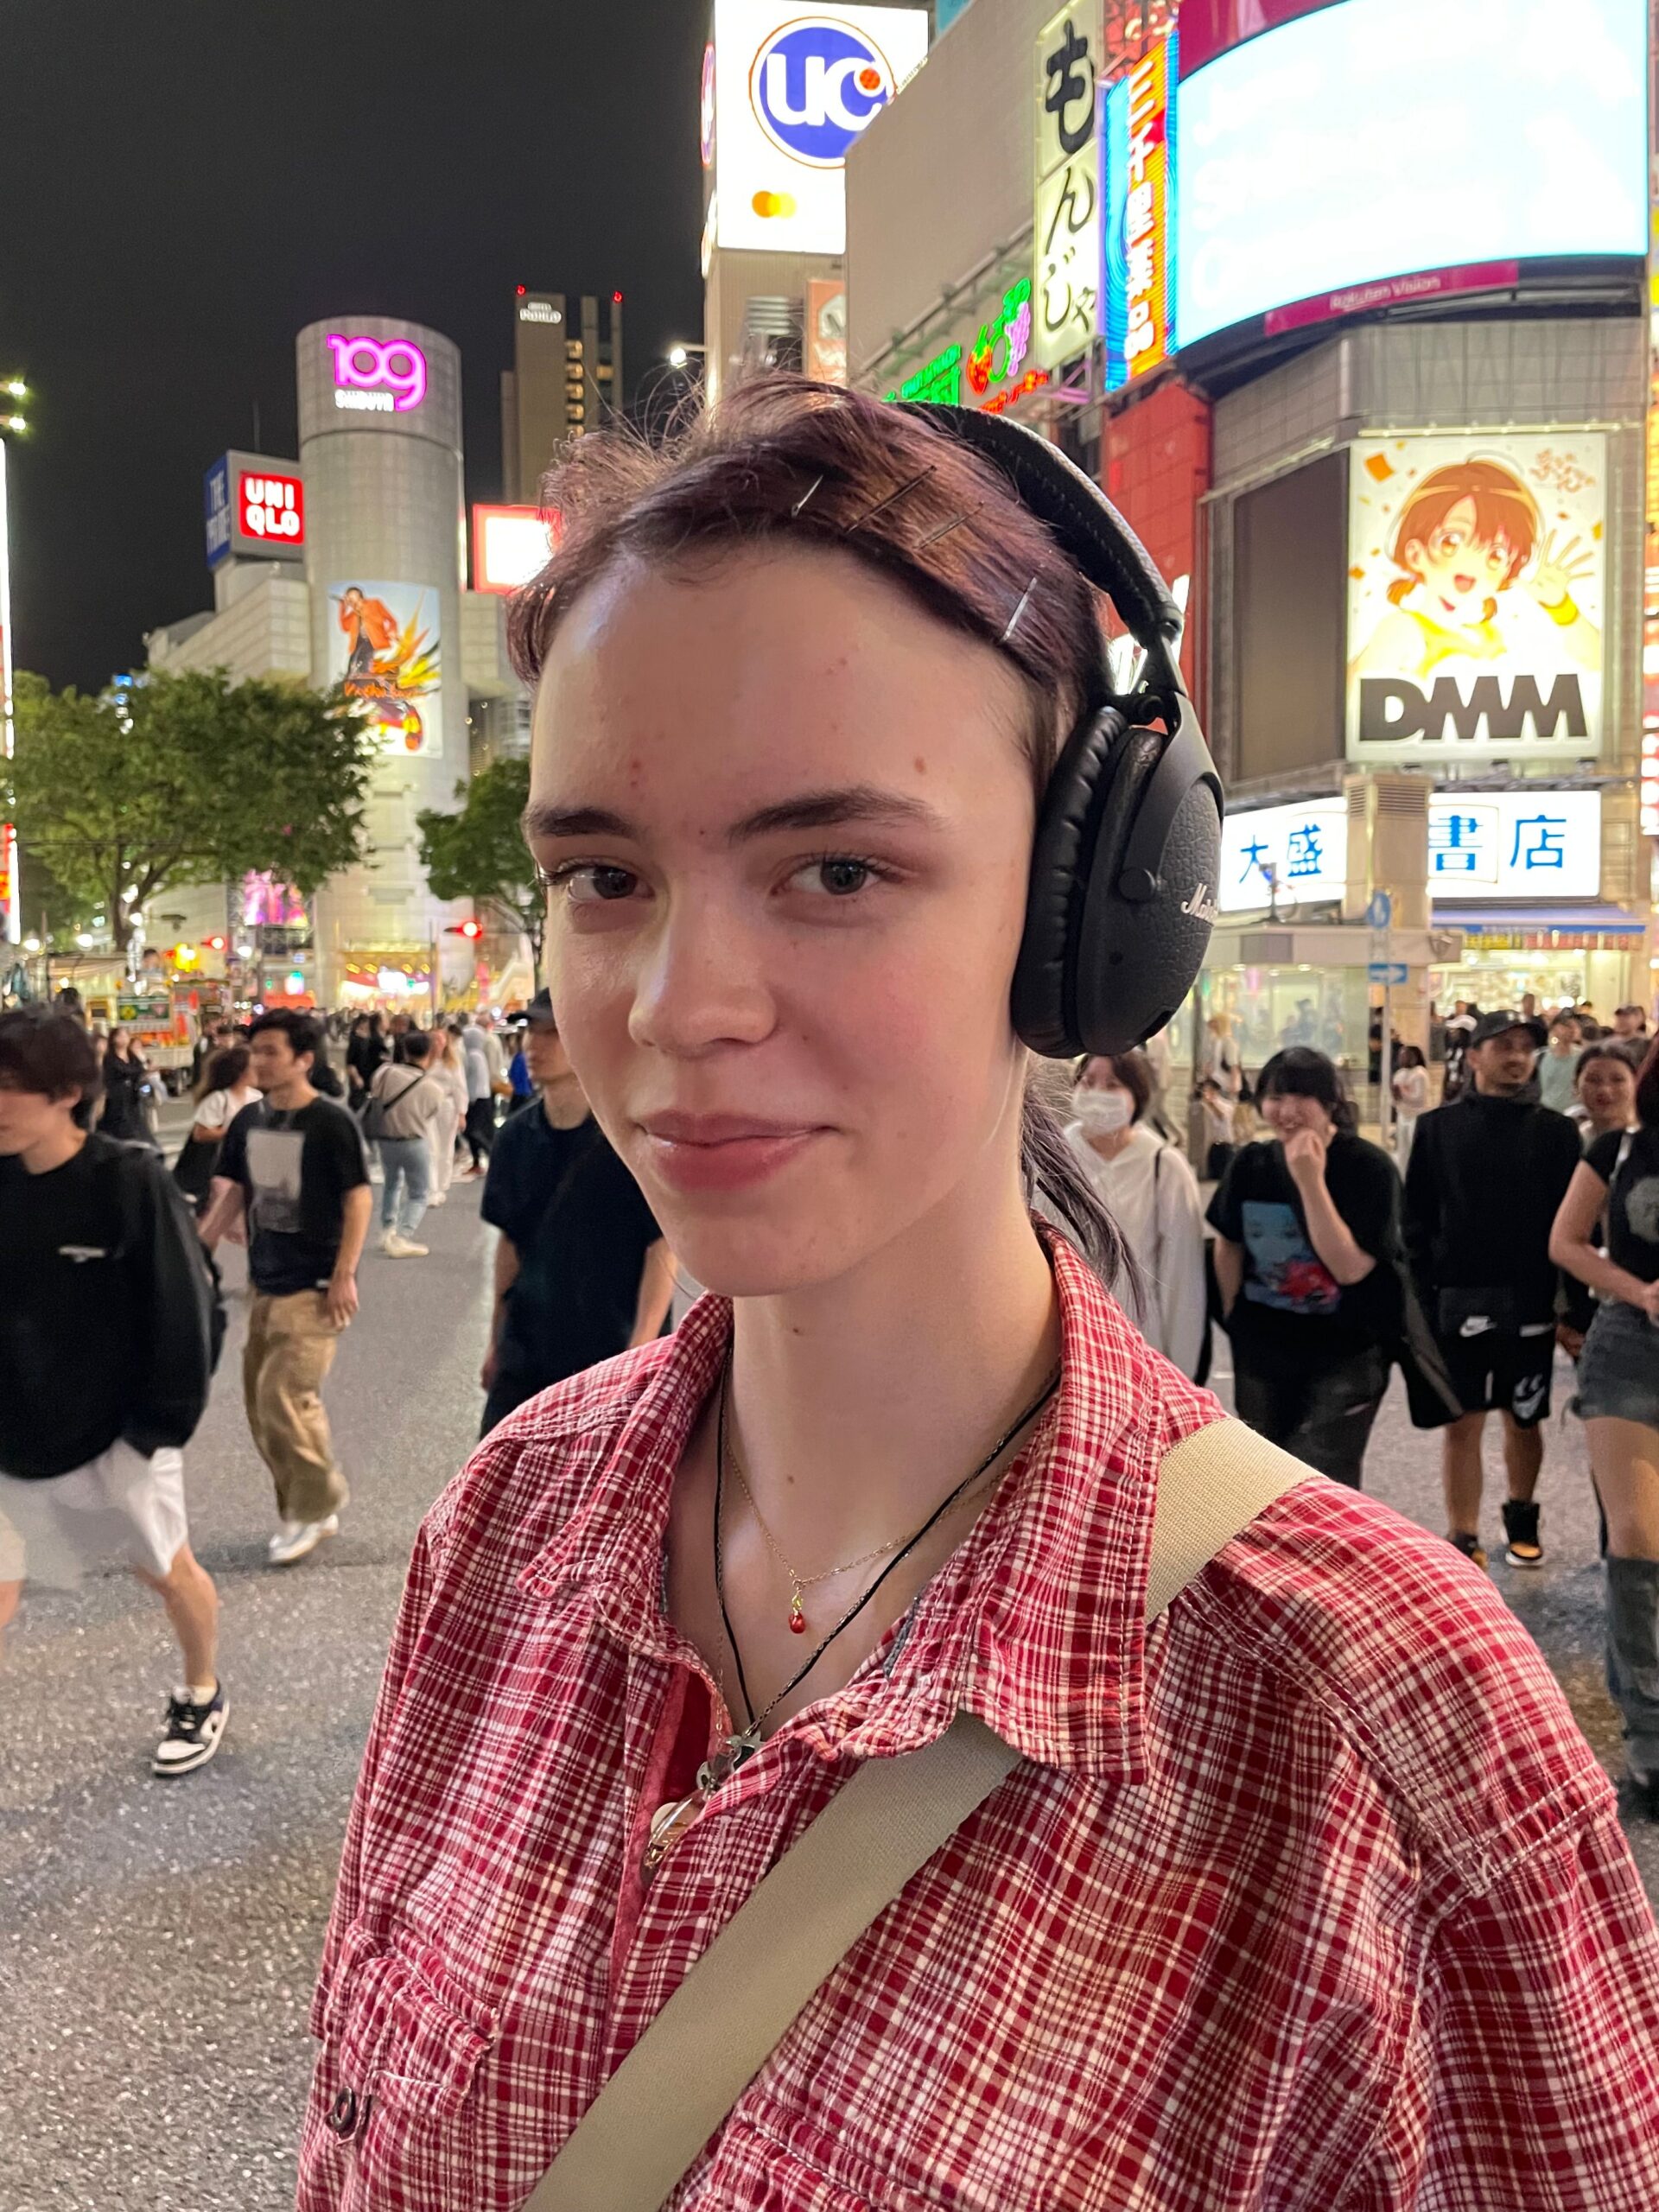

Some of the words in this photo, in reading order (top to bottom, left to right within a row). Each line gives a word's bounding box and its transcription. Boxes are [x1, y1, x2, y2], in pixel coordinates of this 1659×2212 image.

[1045, 19, 1096, 333] もんじゃ
[327, 334, 427, 412] 109
[245, 477, 295, 511] UNI
[245, 504, 301, 537] QLO
[1358, 673, 1588, 742] DMM
